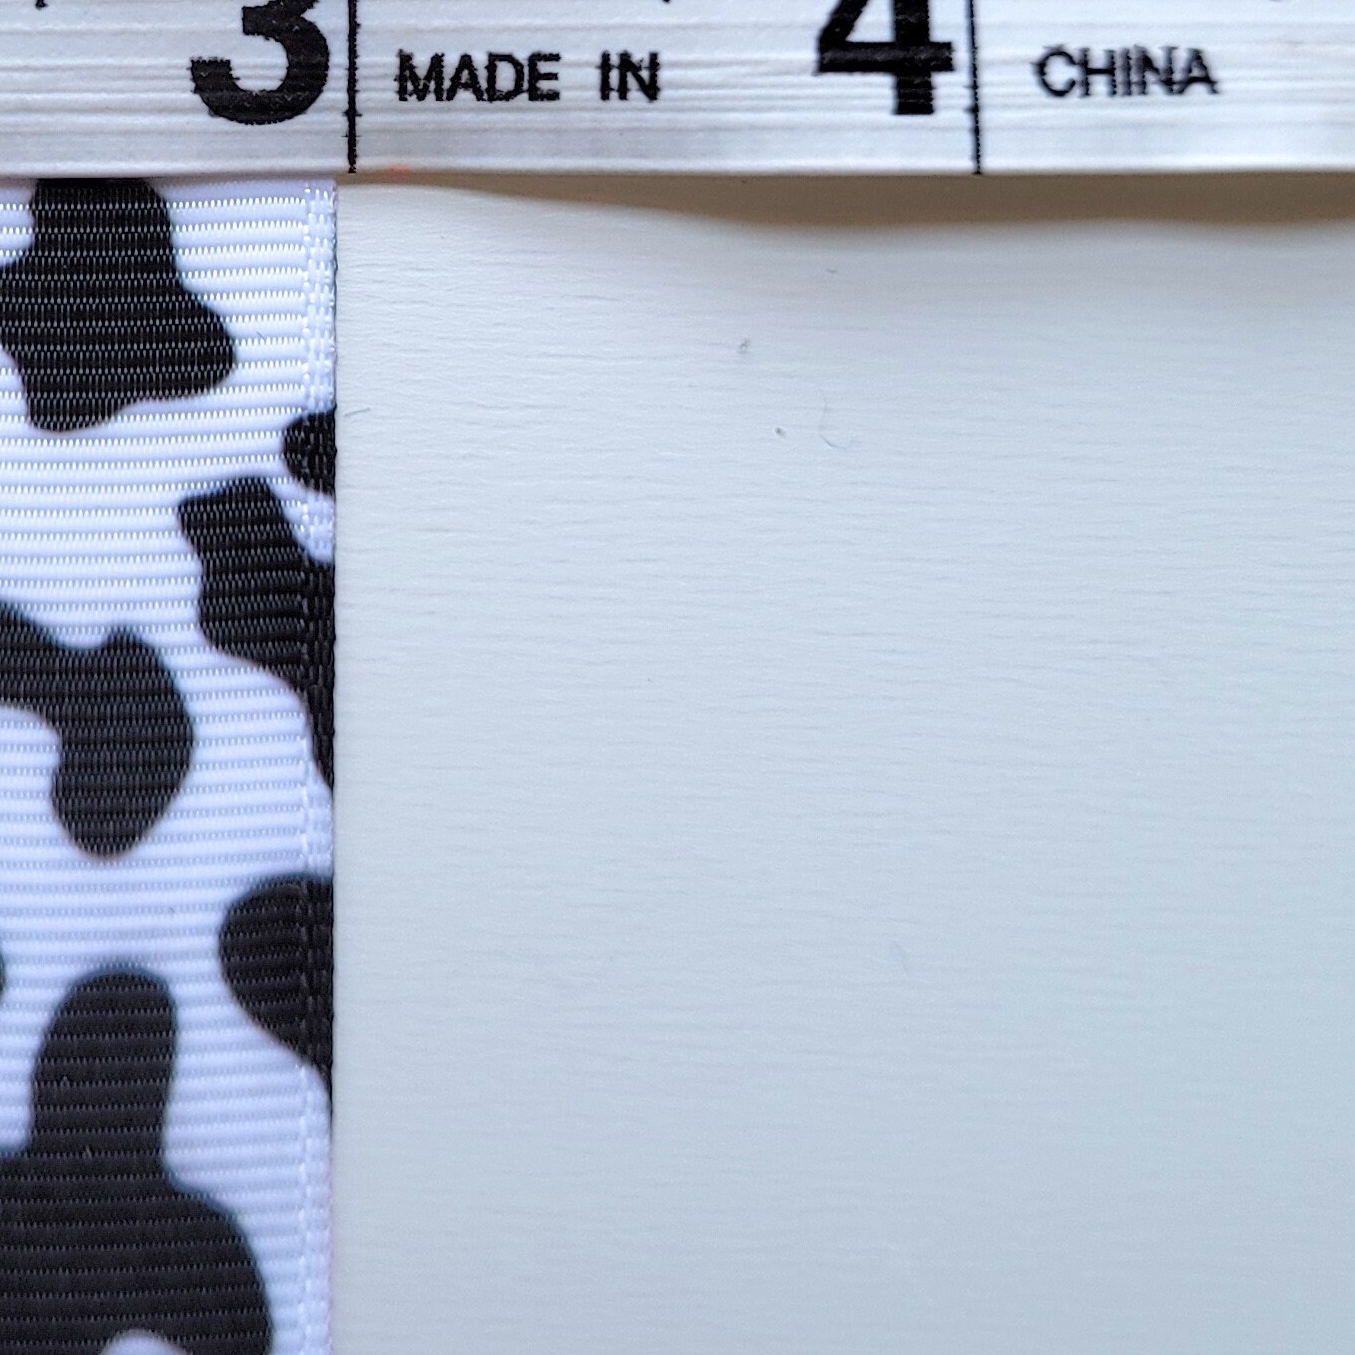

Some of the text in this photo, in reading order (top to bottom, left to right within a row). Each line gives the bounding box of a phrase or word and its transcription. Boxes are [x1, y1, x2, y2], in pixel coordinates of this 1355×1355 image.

[393, 47, 1218, 103] MADE IN CHINA
